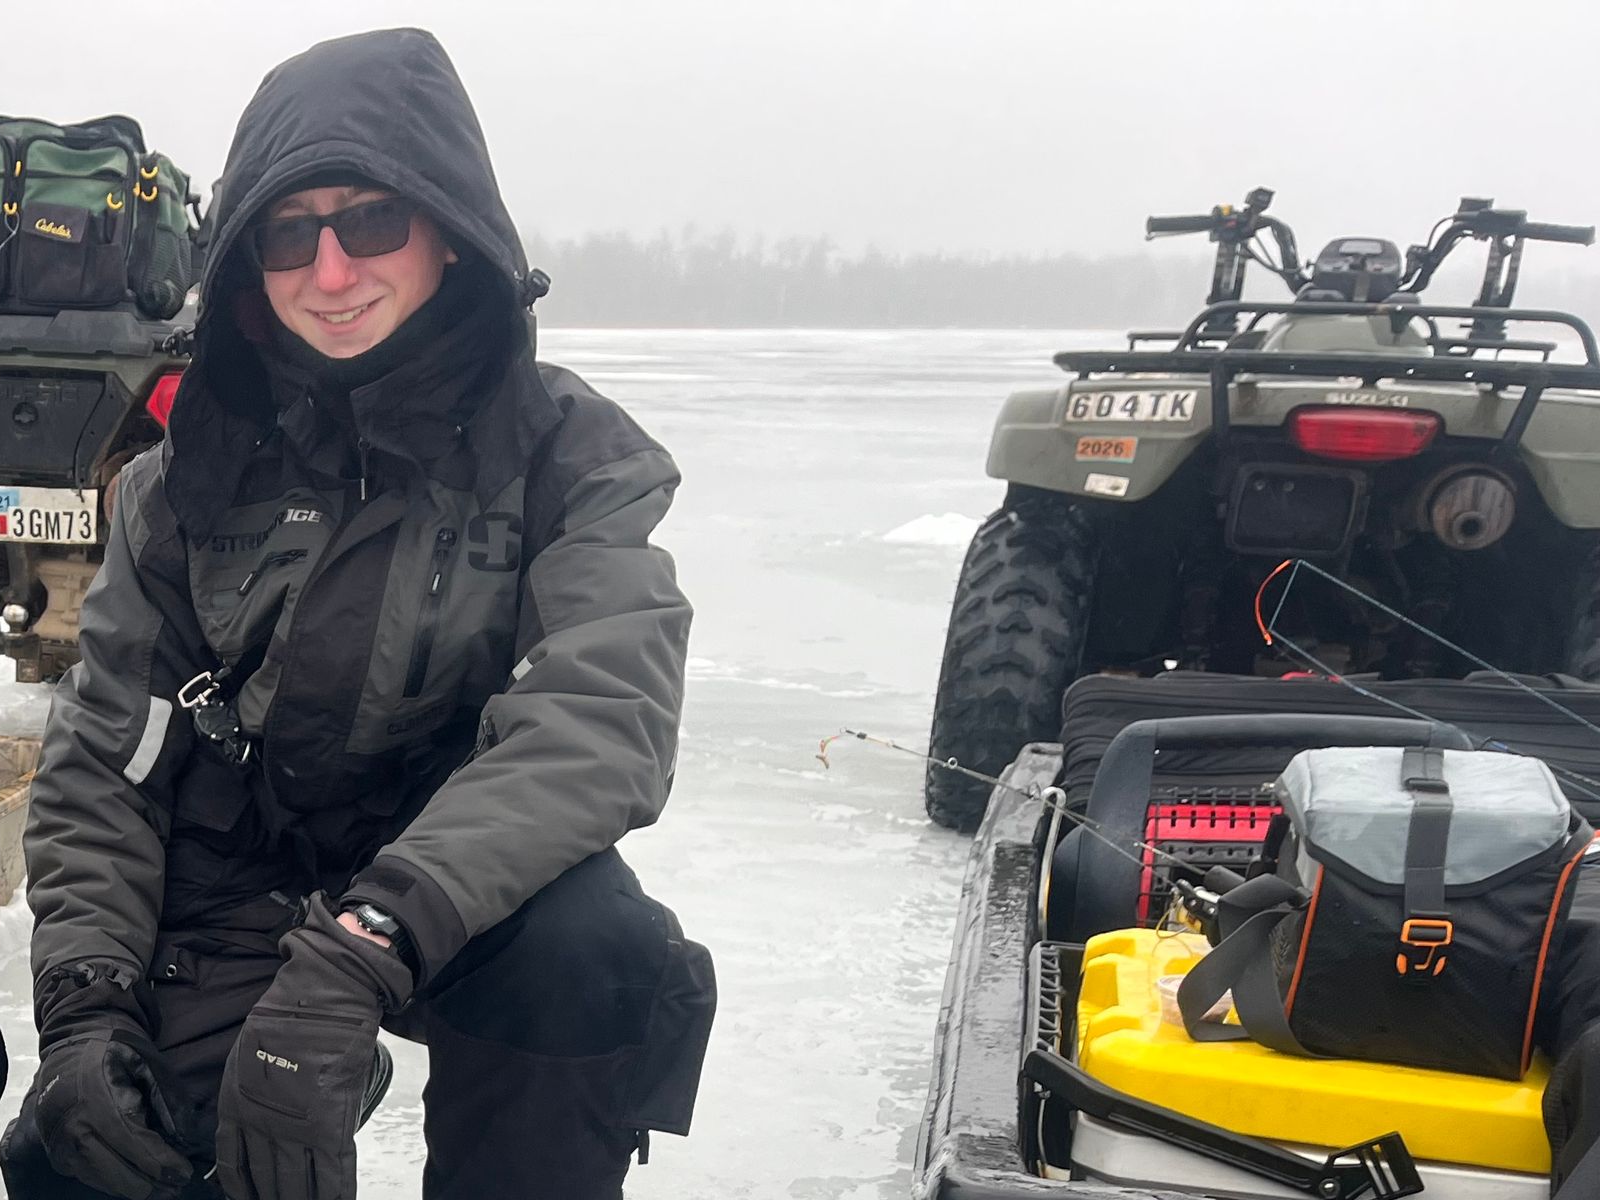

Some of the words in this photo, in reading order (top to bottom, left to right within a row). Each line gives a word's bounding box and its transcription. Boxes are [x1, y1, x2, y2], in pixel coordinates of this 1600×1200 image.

[1325, 392, 1409, 408] SUZUKI
[1078, 441, 1125, 456] 2026
[12, 508, 92, 540] 3GM73
[256, 1049, 299, 1072] HEAD
